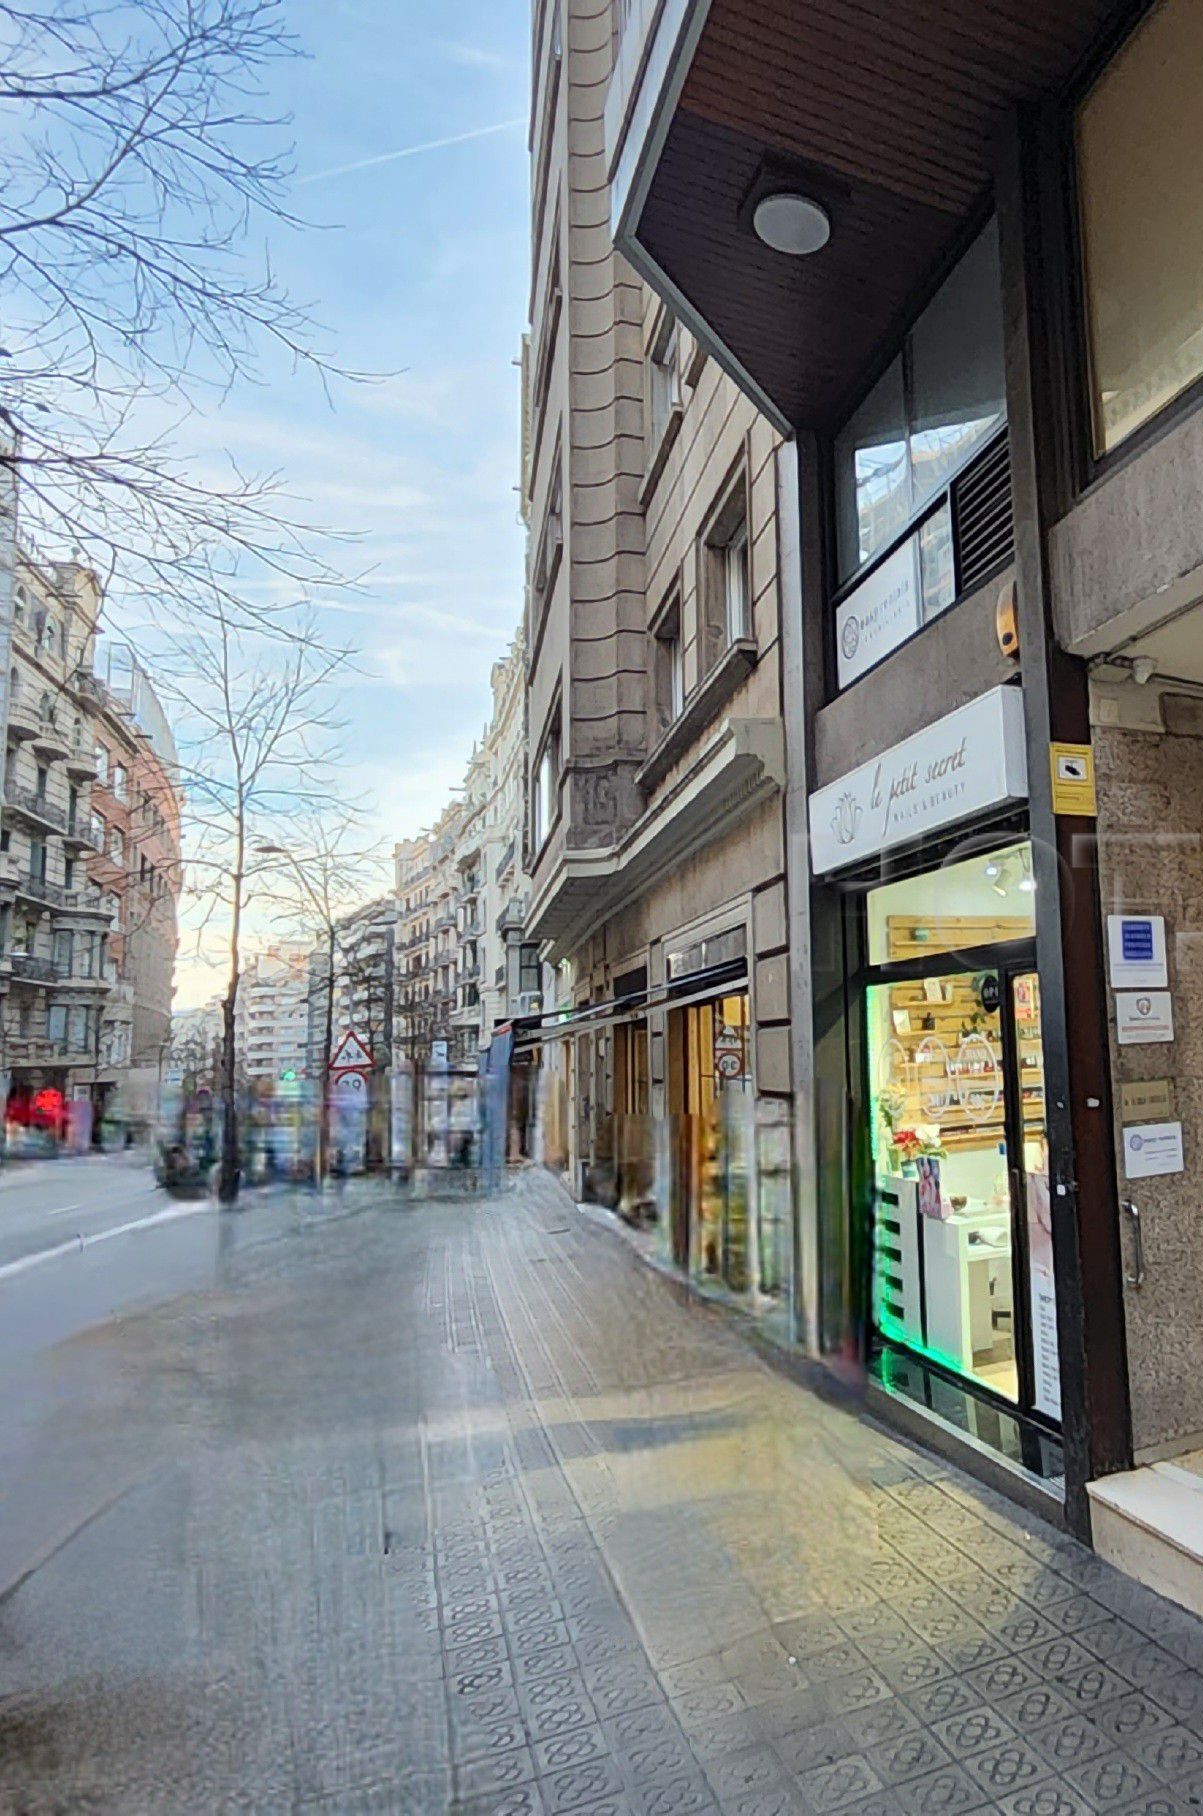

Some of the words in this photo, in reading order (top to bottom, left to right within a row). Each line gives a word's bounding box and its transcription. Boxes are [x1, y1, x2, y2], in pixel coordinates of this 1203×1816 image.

[871, 762, 883, 810] le
[883, 760, 918, 838] petit
[925, 737, 967, 784] secret
